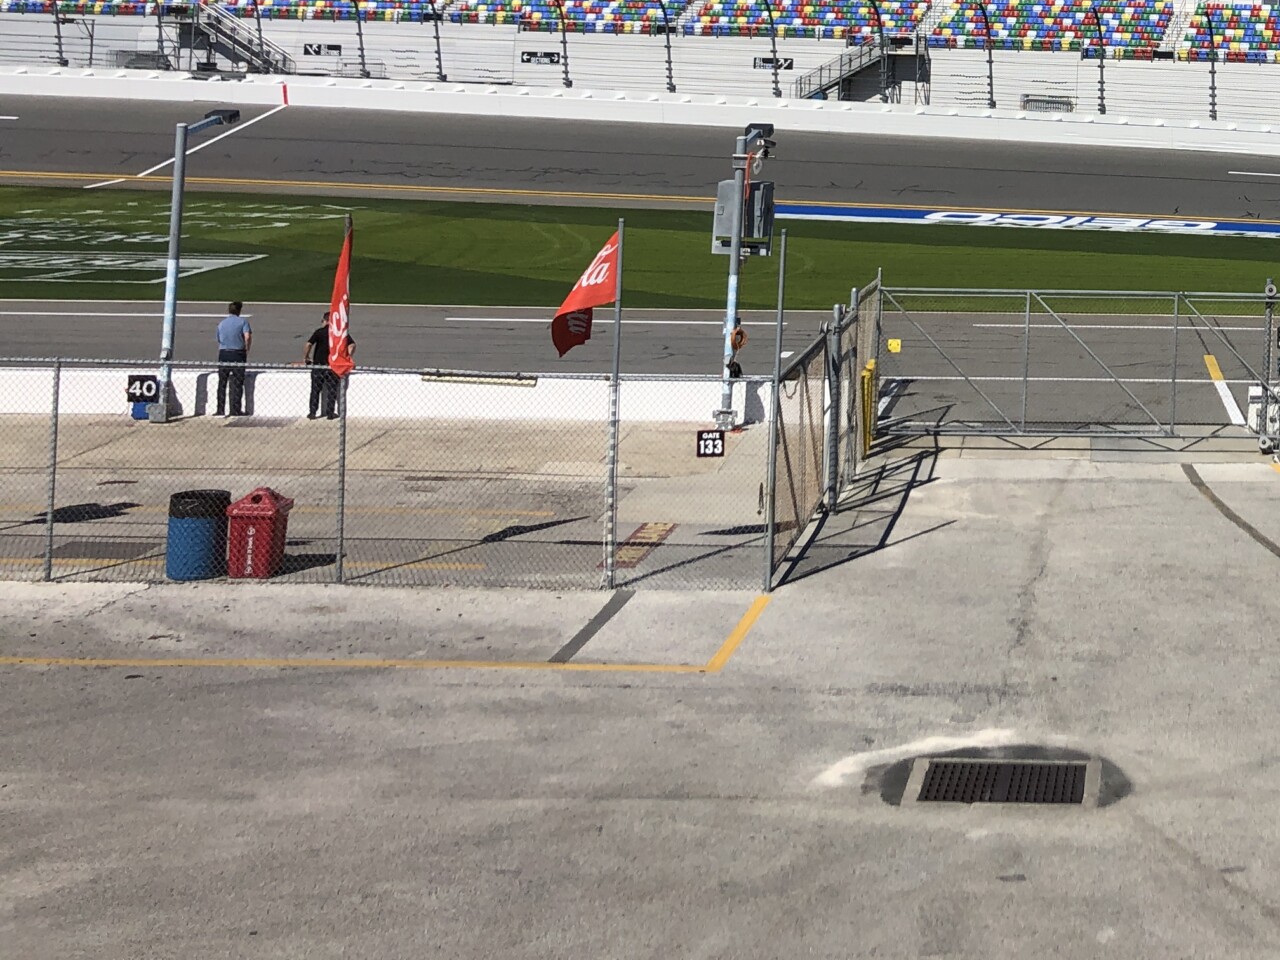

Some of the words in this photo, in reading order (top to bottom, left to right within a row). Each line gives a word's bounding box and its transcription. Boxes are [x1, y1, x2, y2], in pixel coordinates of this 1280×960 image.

[924, 211, 1217, 230] GEICO
[129, 380, 157, 397] 40
[699, 440, 723, 454] 133
